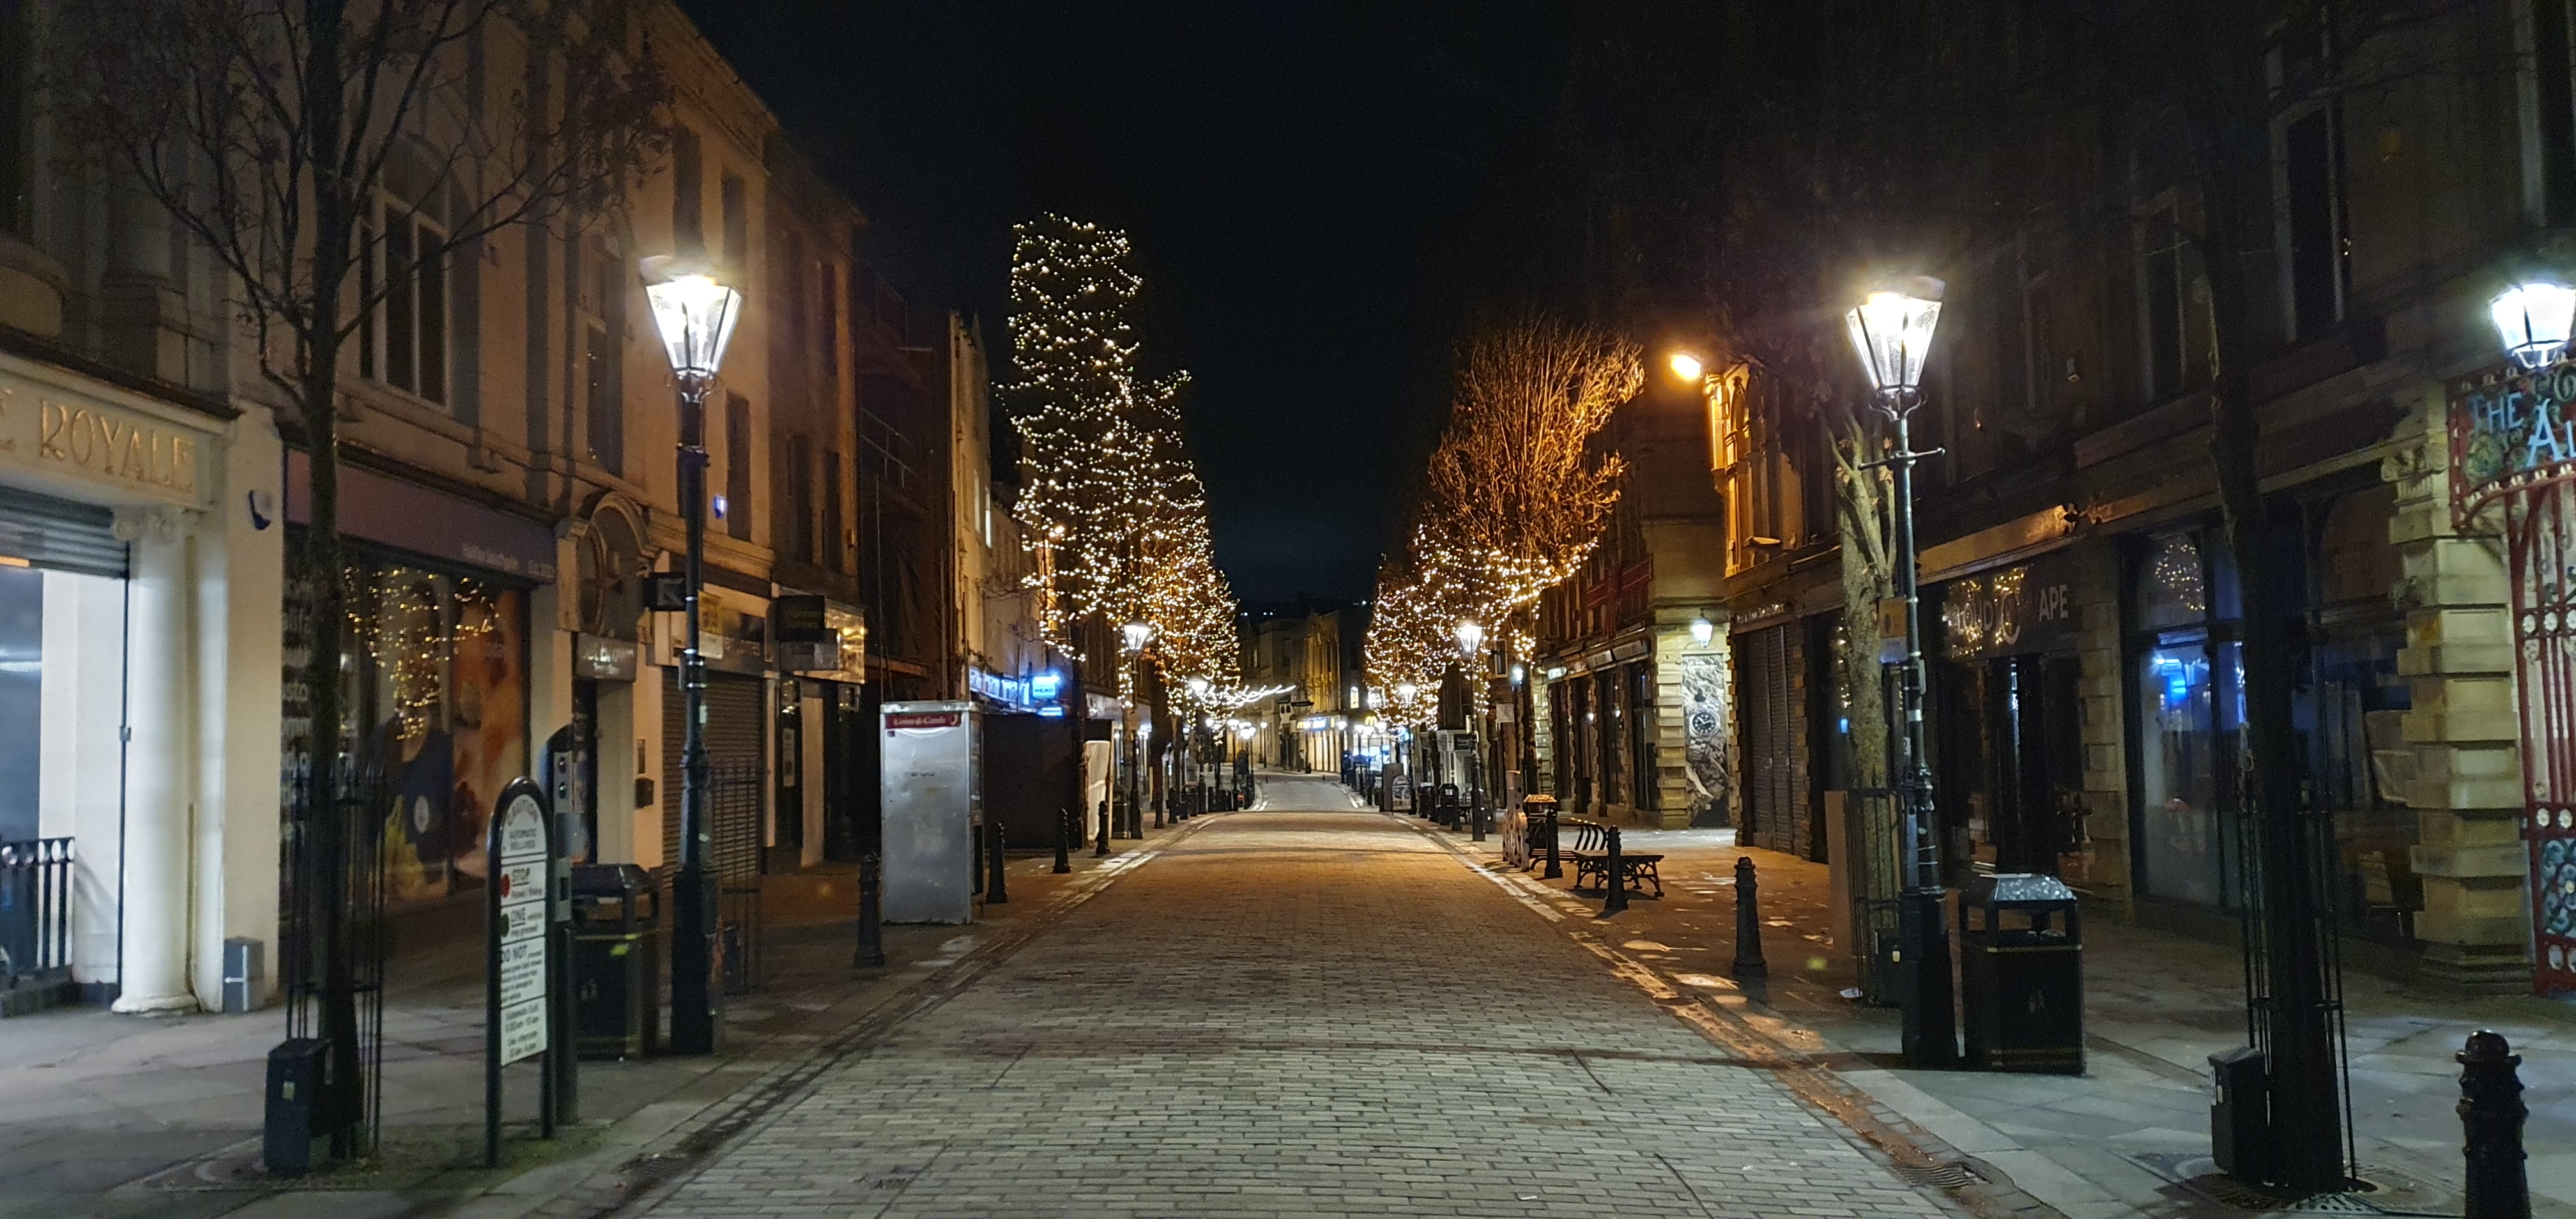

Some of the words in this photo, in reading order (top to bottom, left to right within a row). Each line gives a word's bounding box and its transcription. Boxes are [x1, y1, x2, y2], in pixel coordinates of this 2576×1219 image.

[2467, 391, 2524, 437] THE
[40, 399, 194, 492] ROYALE
[510, 866, 530, 882] STOP
[510, 907, 526, 923] ONE
